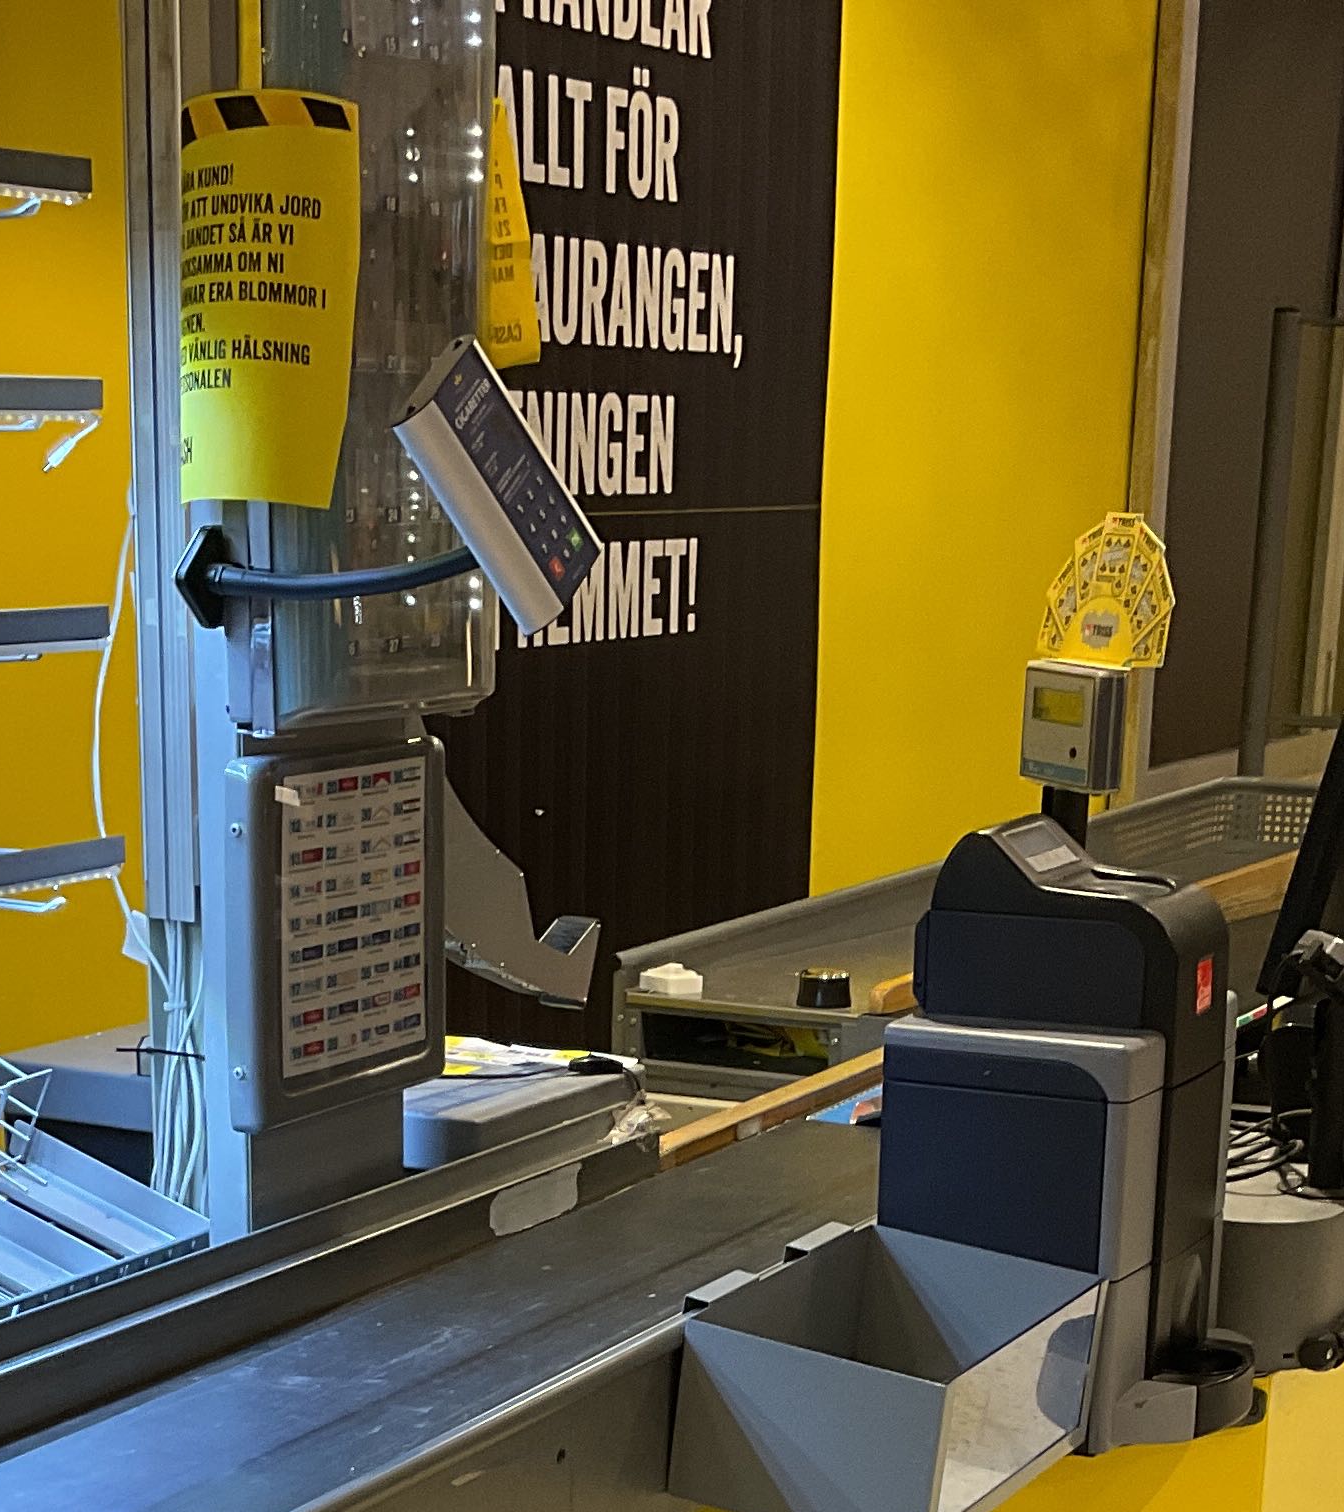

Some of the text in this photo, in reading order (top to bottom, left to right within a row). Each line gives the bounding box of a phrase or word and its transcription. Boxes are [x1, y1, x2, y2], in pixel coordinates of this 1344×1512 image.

[606, 66, 679, 202] FÖR
[198, 163, 234, 189] KUND!
[211, 193, 274, 216] UNDVIKA
[280, 195, 322, 219] JORD
[229, 216, 246, 243] SÅ
[252, 218, 272, 244] ÄR
[278, 224, 294, 245] VI
[238, 252, 261, 272] OM
[268, 252, 284, 273] NI
[209, 280, 233, 302] ERA
[239, 280, 317, 309] BLOMMOR
[321, 288, 326, 310] I
[189, 337, 226, 362] VÄNLIG
[232, 334, 310, 366] HÄLSNING
[508, 390, 675, 496] NINGEN
[518, 537, 698, 649] MMET!
